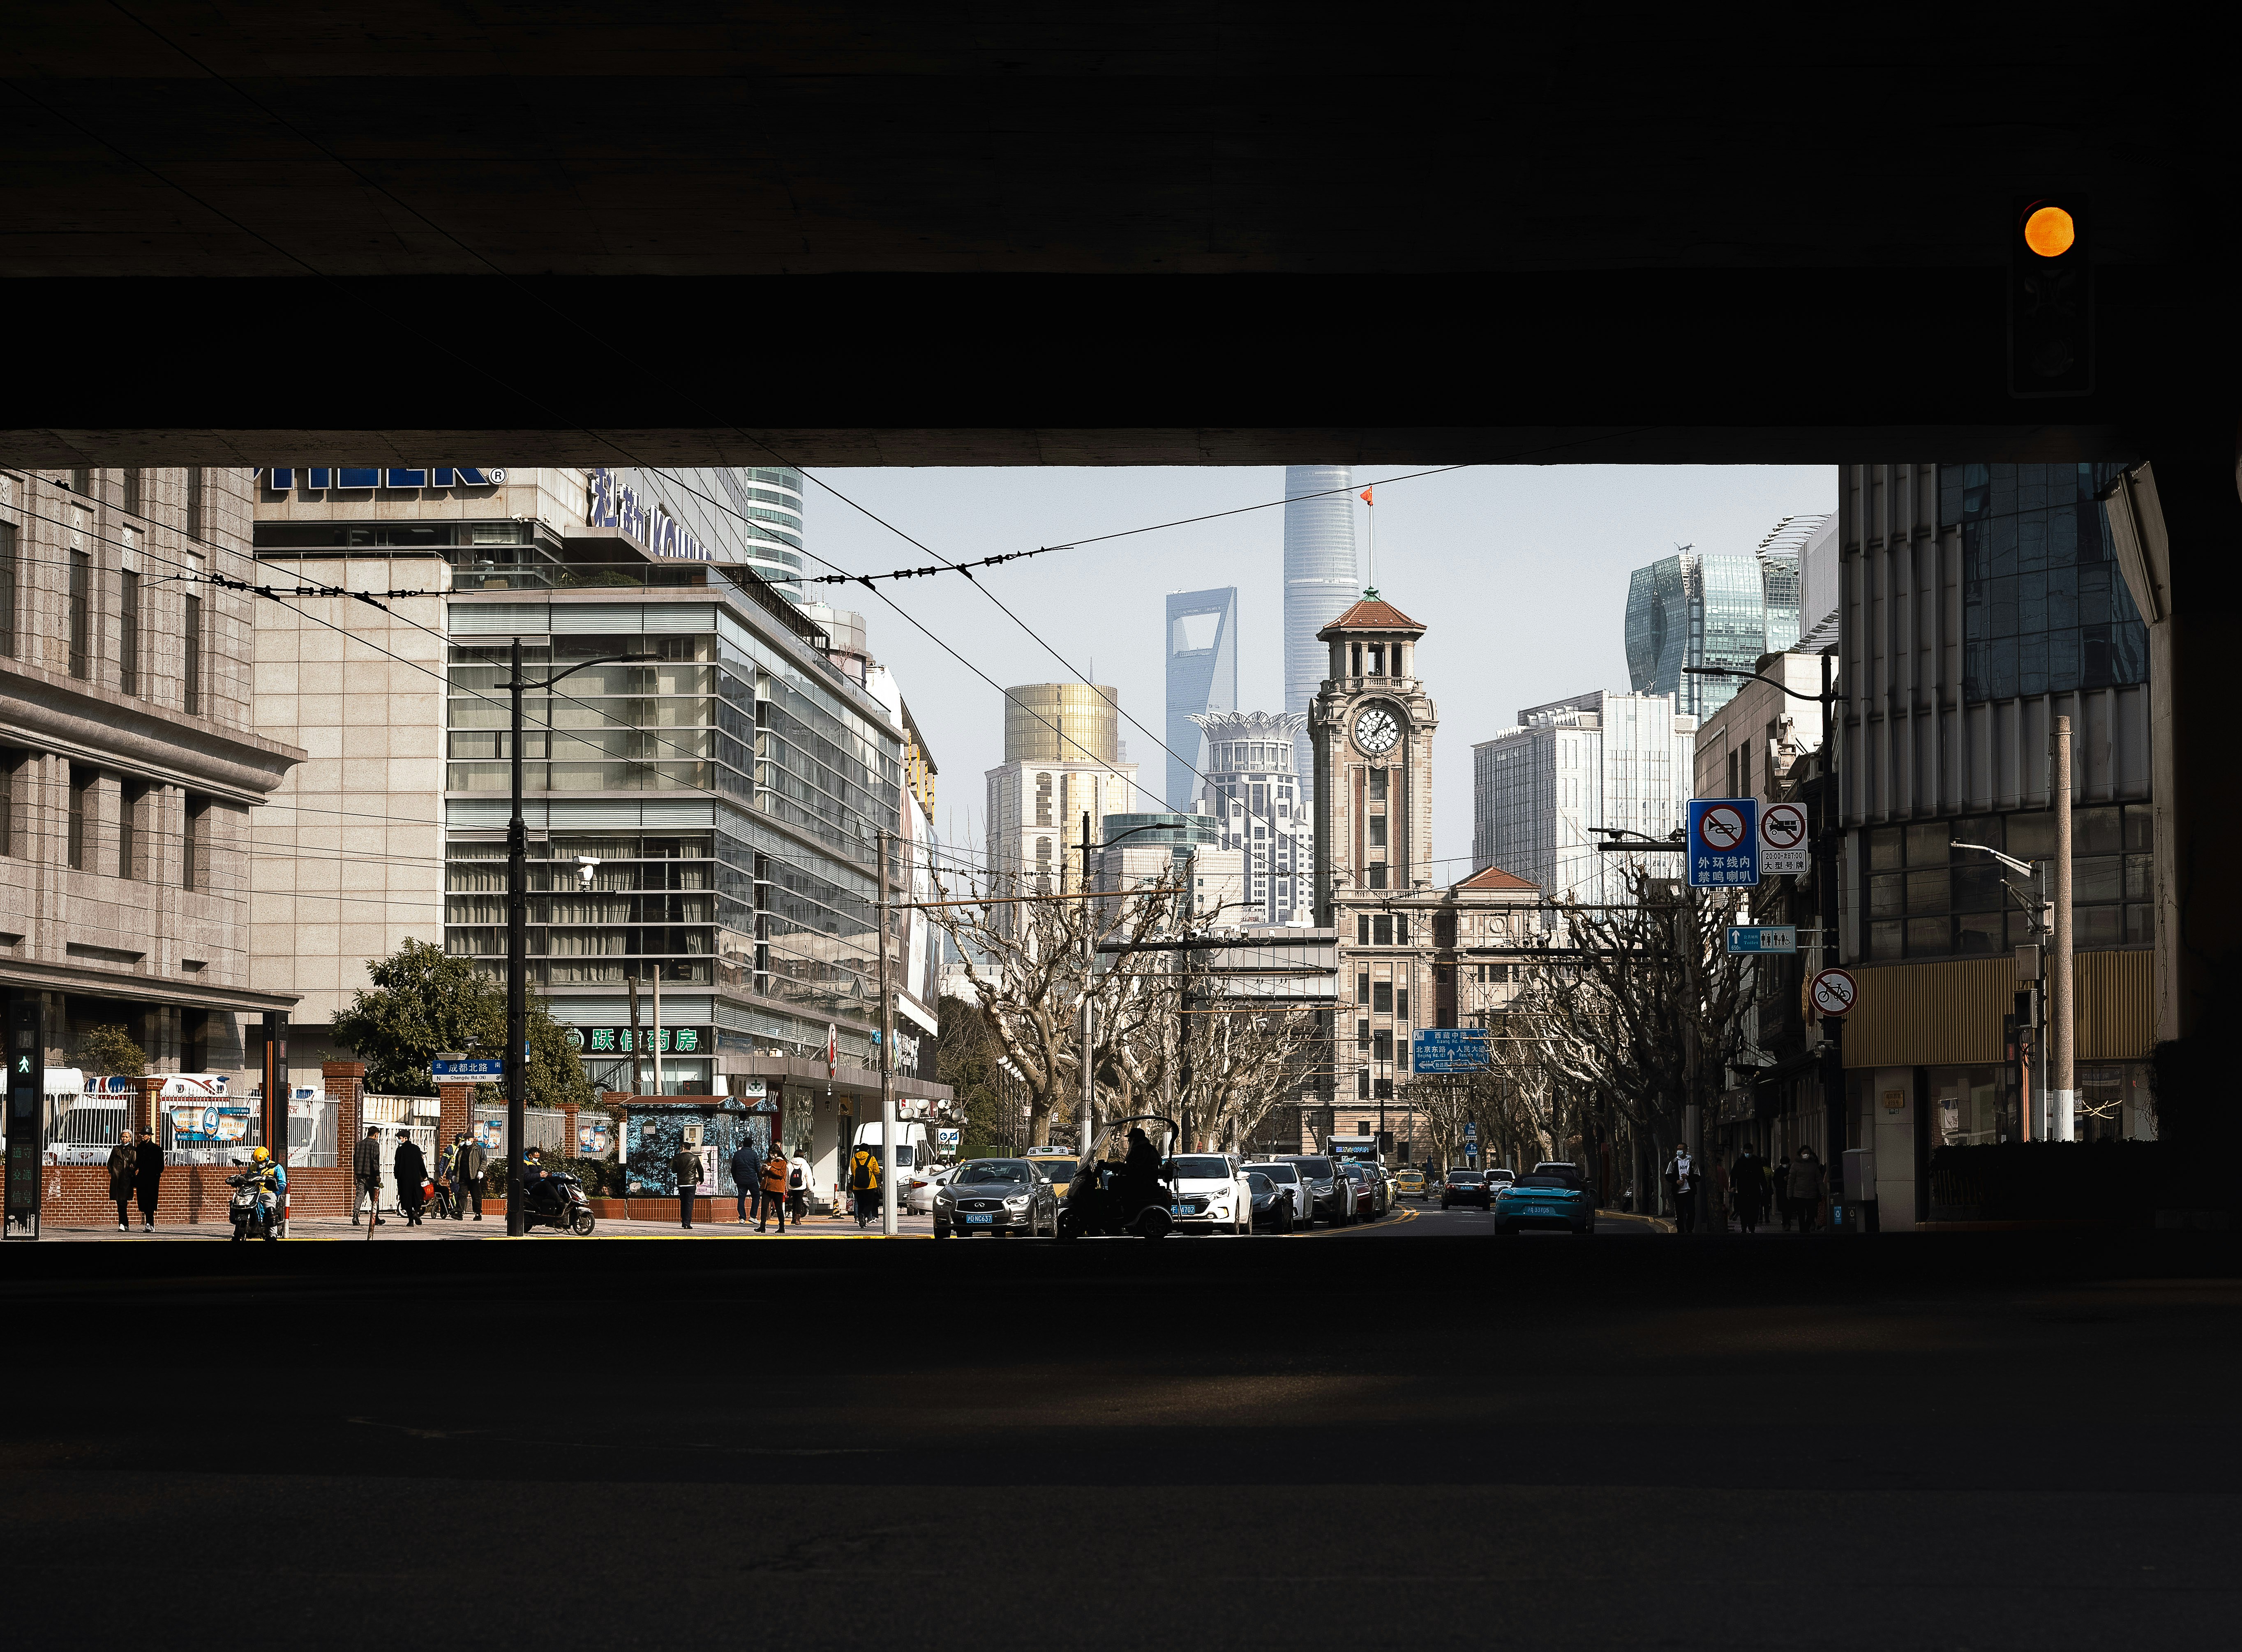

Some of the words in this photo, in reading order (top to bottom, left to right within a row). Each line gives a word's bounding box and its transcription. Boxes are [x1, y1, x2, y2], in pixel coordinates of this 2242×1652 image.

[1698, 856, 1749, 869] 外环线内
[1764, 861, 1804, 870] 大型号牌
[1698, 870, 1751, 883] 禁鸣喇叭
[449, 1064, 487, 1072] 成都北路
[13, 1147, 32, 1158] 遵守
[13, 1167, 31, 1180] 交通
[12, 1190, 32, 1203] 信号
